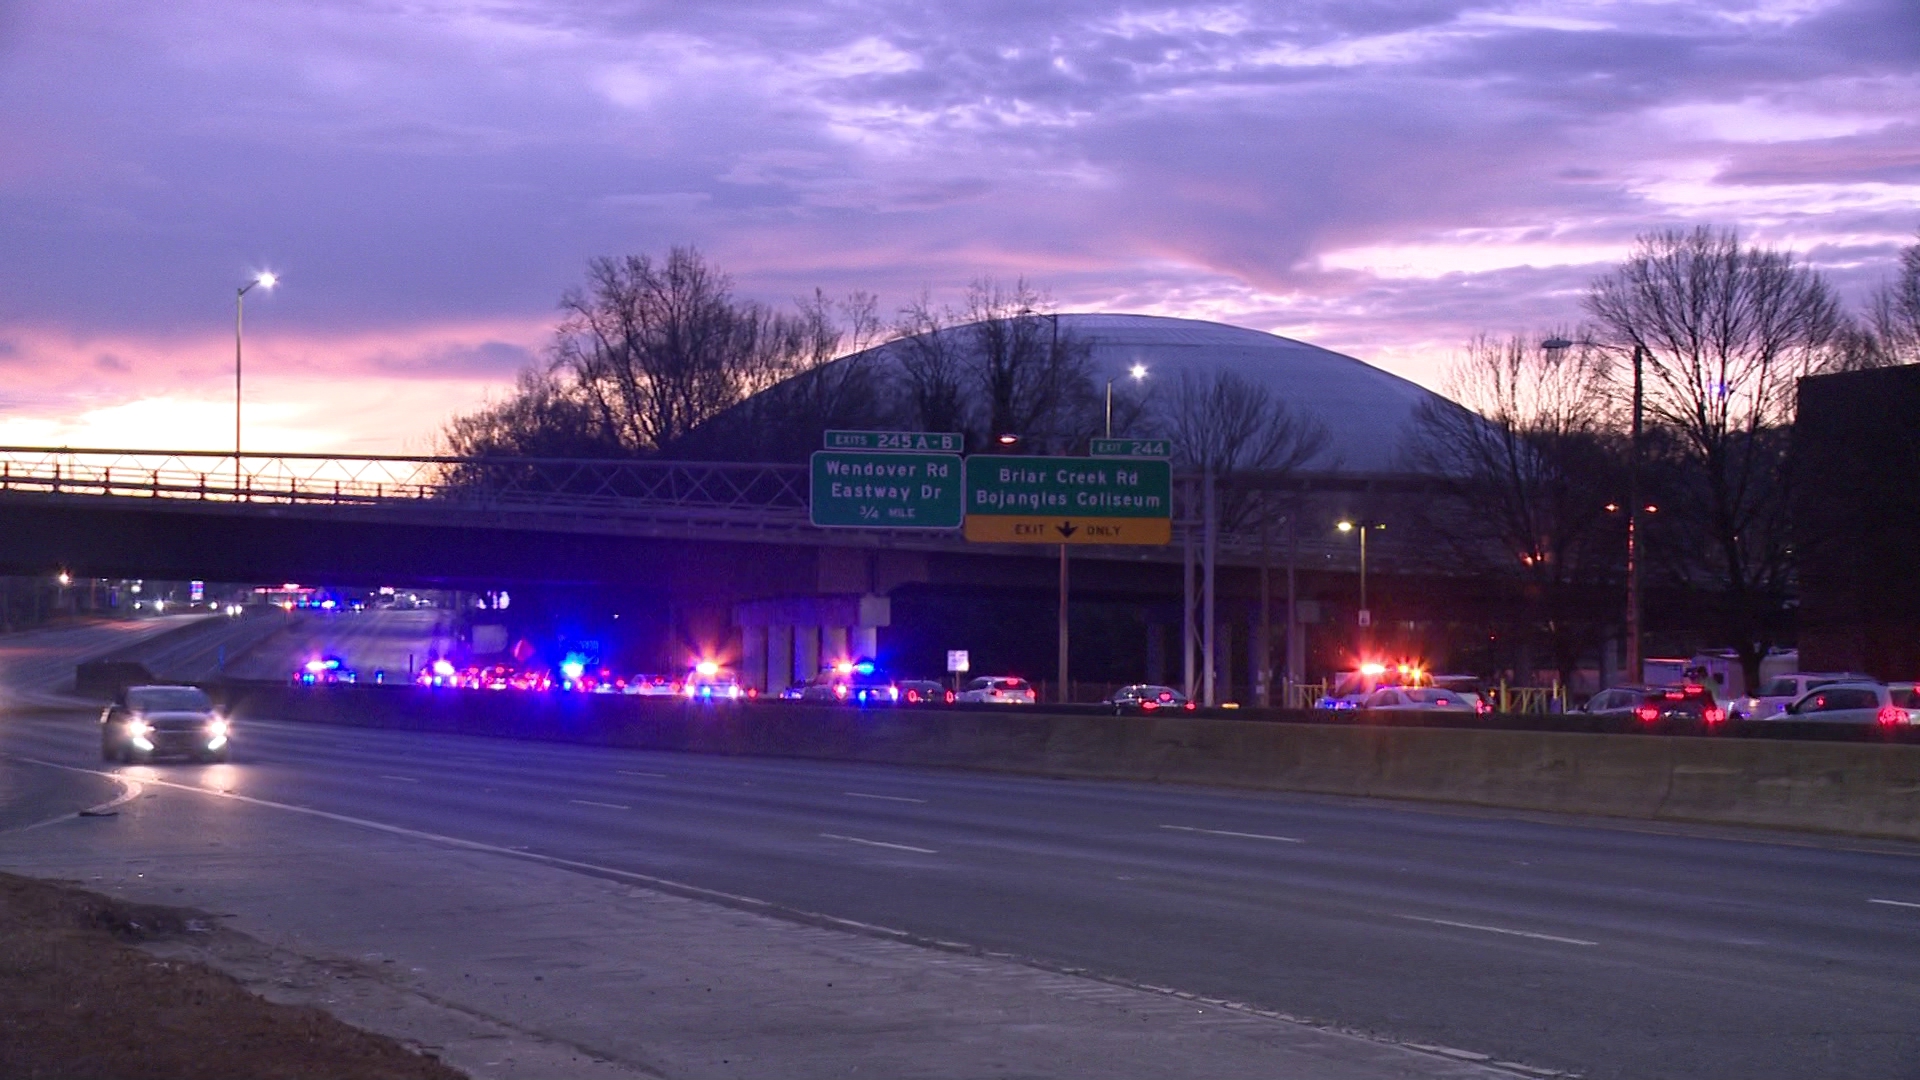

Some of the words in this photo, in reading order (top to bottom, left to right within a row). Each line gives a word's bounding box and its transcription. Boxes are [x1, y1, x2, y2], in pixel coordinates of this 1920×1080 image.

[834, 434, 867, 446] EXITS
[1099, 442, 1121, 452] EXIT
[1132, 442, 1164, 455] 244
[826, 460, 917, 476] Wendover
[926, 463, 949, 477] Rd
[1000, 468, 1047, 483] Briar
[1056, 469, 1107, 485] Creek
[1116, 470, 1139, 486] Rd
[831, 482, 910, 502] Eastway
[921, 484, 942, 499] Dr
[976, 489, 1067, 509] Bojangles
[1076, 491, 1160, 508] Coliseum
[889, 508, 916, 518] MILE
[1014, 523, 1044, 534] EXIT
[1087, 525, 1121, 536] ONLY
